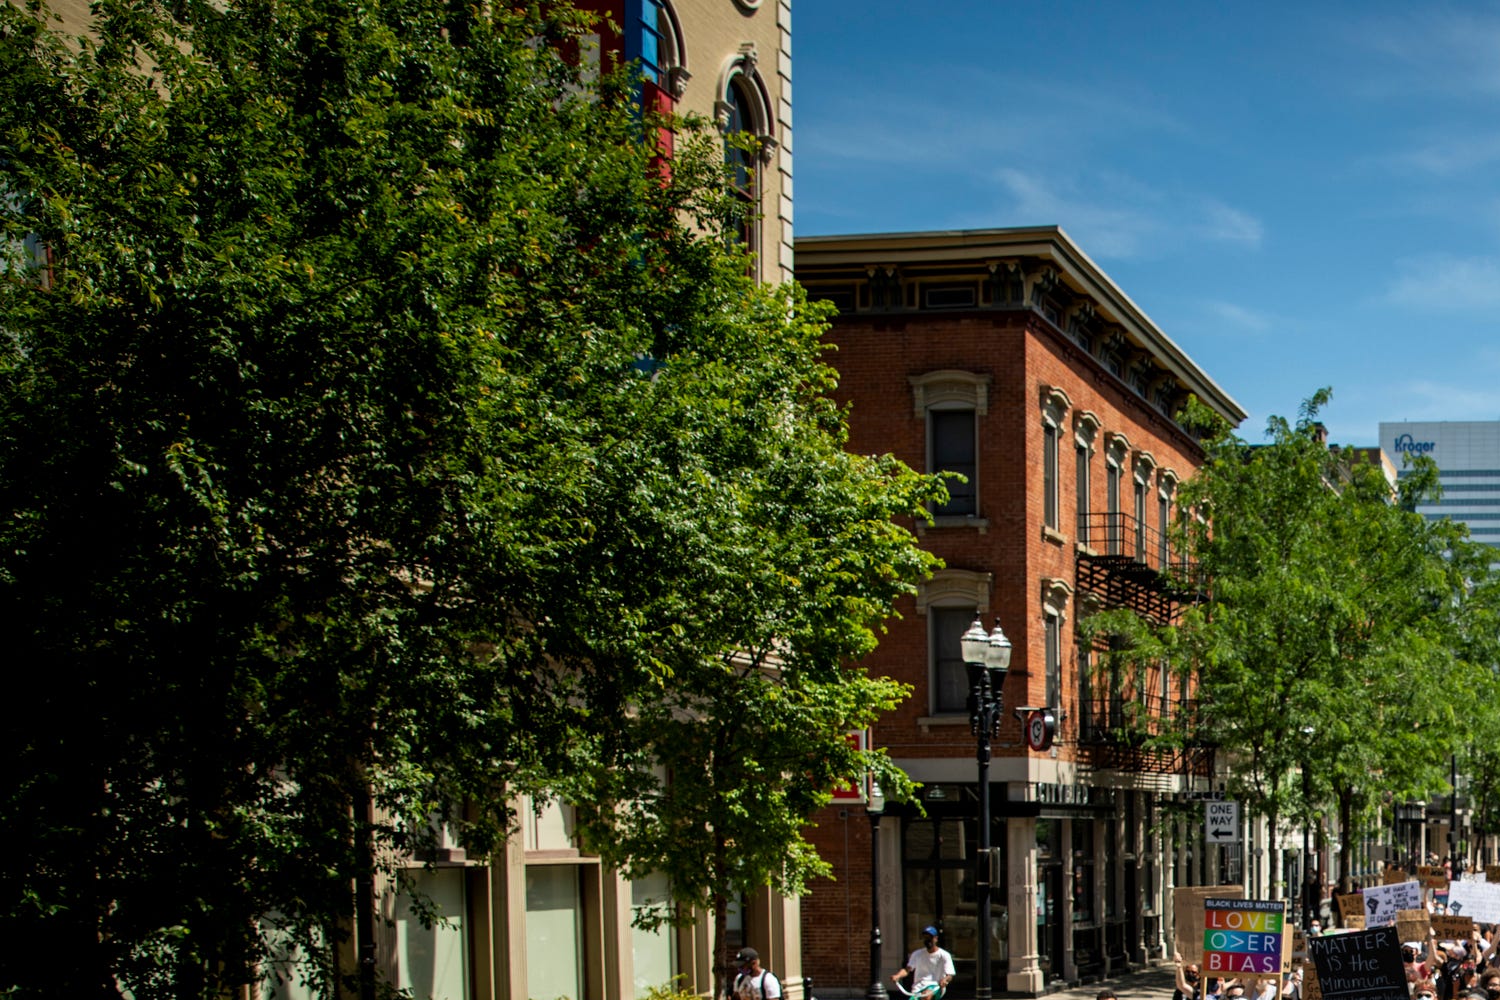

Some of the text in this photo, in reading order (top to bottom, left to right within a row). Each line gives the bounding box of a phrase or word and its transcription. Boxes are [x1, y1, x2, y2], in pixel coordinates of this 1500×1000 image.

[1394, 434, 1435, 457] Kroger
[1210, 804, 1233, 814] ONE
[1210, 816, 1233, 825] WAY
[1206, 900, 1284, 910] BLACK LIVES MATTER
[1211, 911, 1277, 931] LOVE
[1209, 953, 1275, 974] BIAS
[1345, 953, 1380, 972] the
